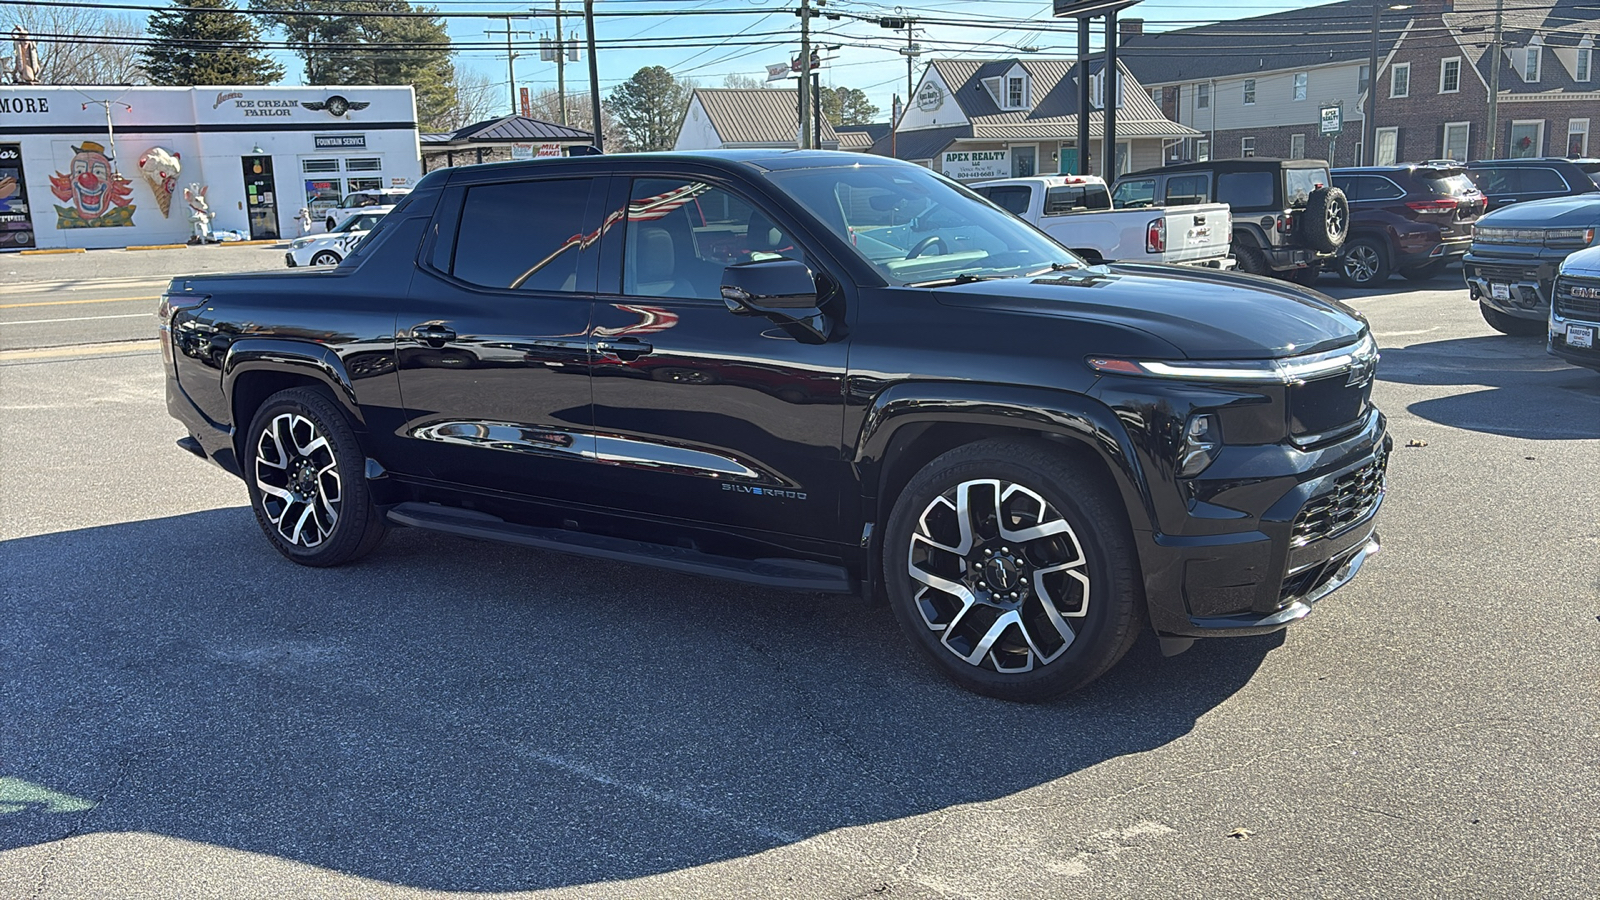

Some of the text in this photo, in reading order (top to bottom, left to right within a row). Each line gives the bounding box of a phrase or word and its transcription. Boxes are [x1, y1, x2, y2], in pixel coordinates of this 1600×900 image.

[235, 100, 255, 108] ICE
[257, 100, 299, 108] CREAM
[244, 109, 292, 117] PARLOR
[316, 137, 364, 146] FOUNTAIN SERVICE
[946, 151, 1006, 162] APEX REALTY
[1571, 286, 1600, 298] GMC
[1569, 328, 1590, 337] BAREFORD
[721, 483, 807, 500] SILVERADO
